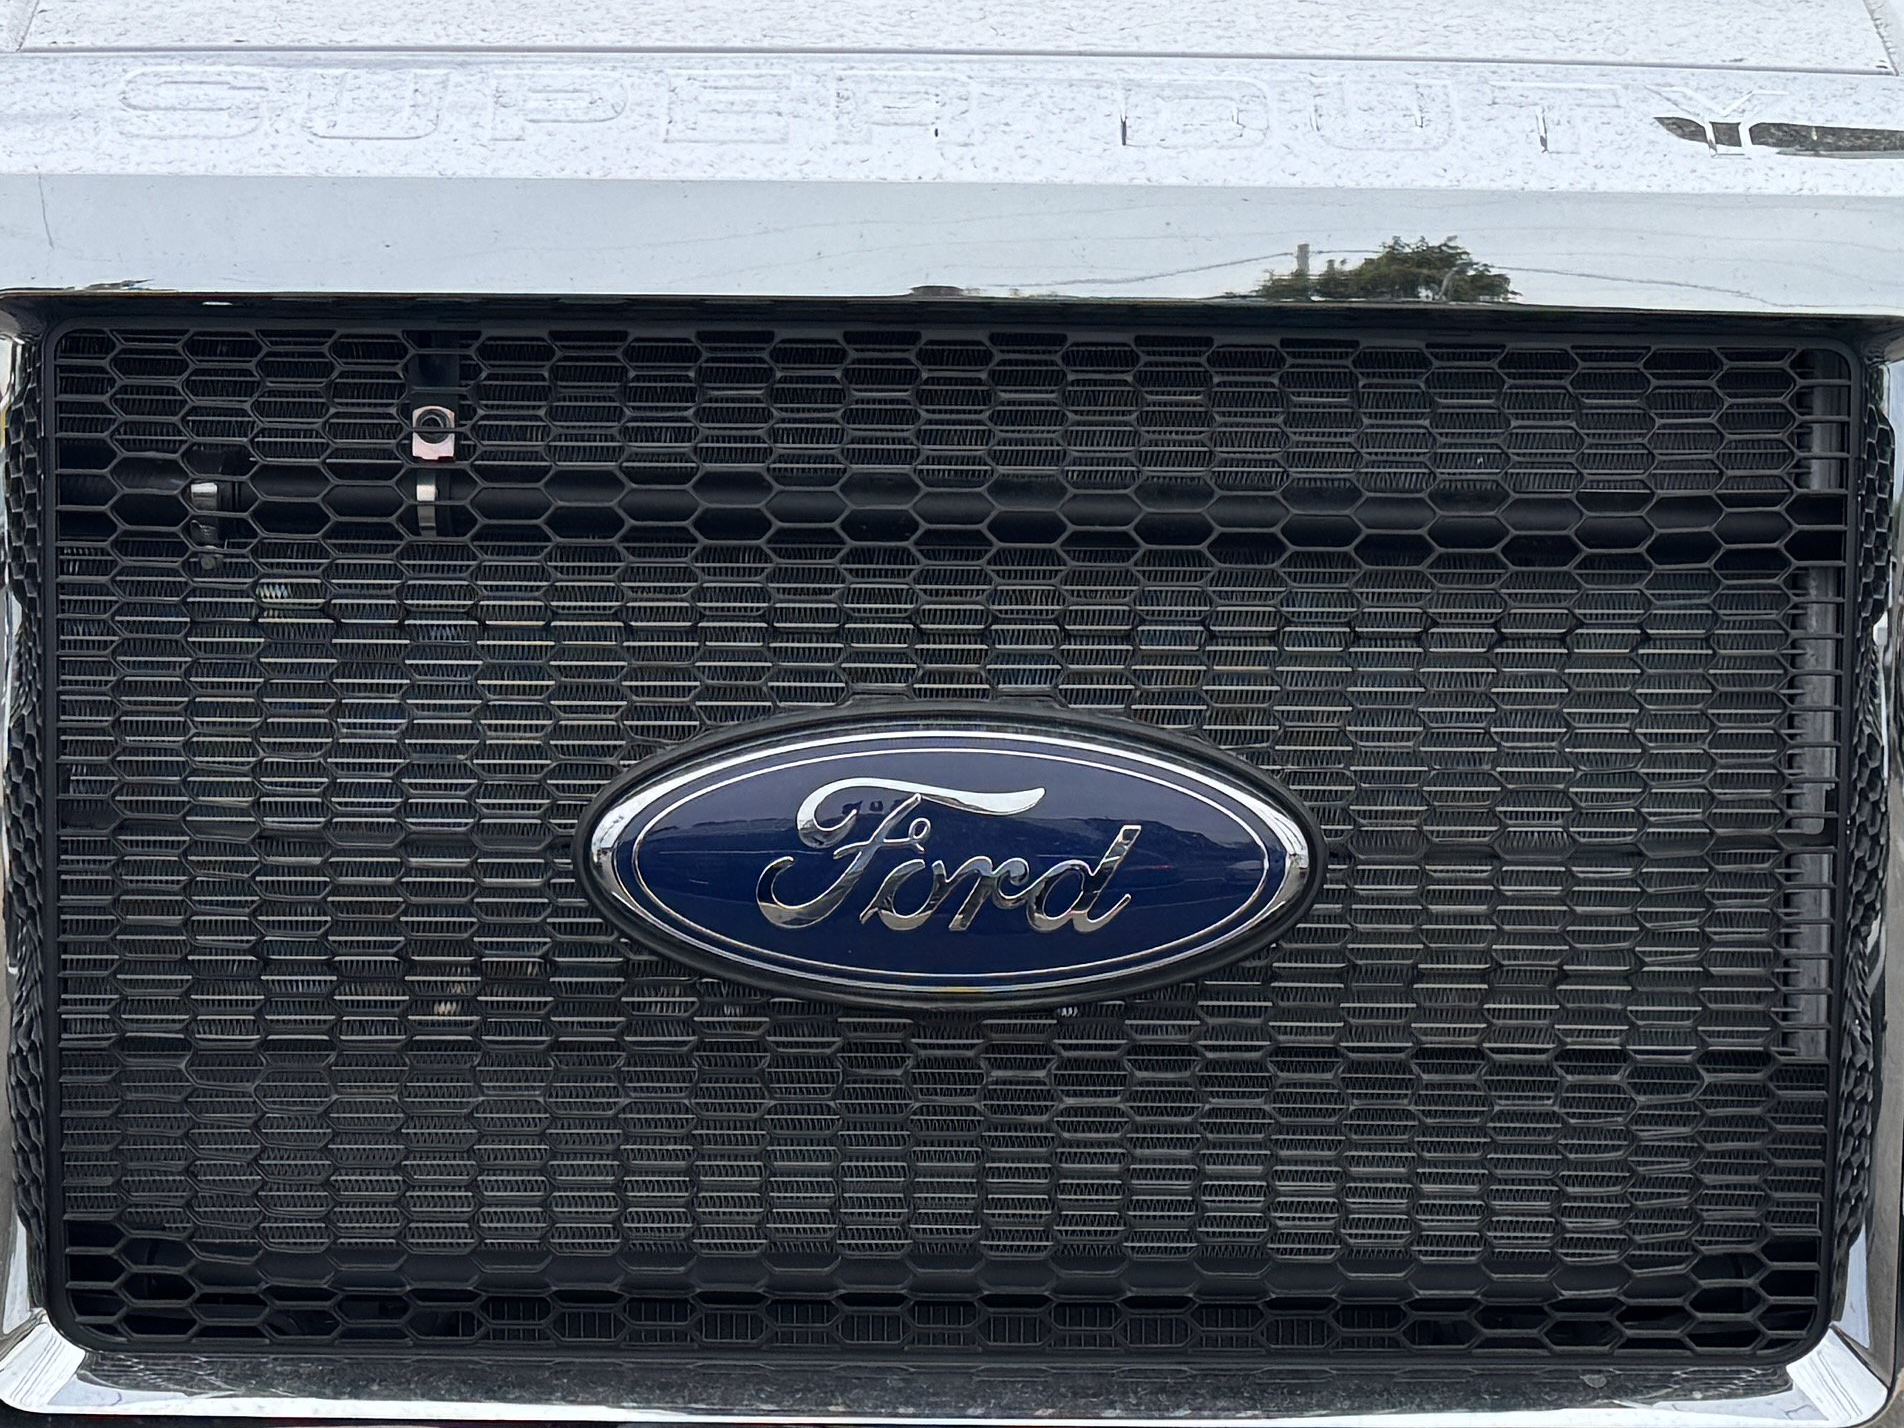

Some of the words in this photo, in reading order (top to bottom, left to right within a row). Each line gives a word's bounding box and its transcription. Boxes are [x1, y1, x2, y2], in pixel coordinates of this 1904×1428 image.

[114, 64, 976, 146] SUPER
[1114, 72, 1793, 158] DUTY
[756, 777, 1143, 932] Ford
